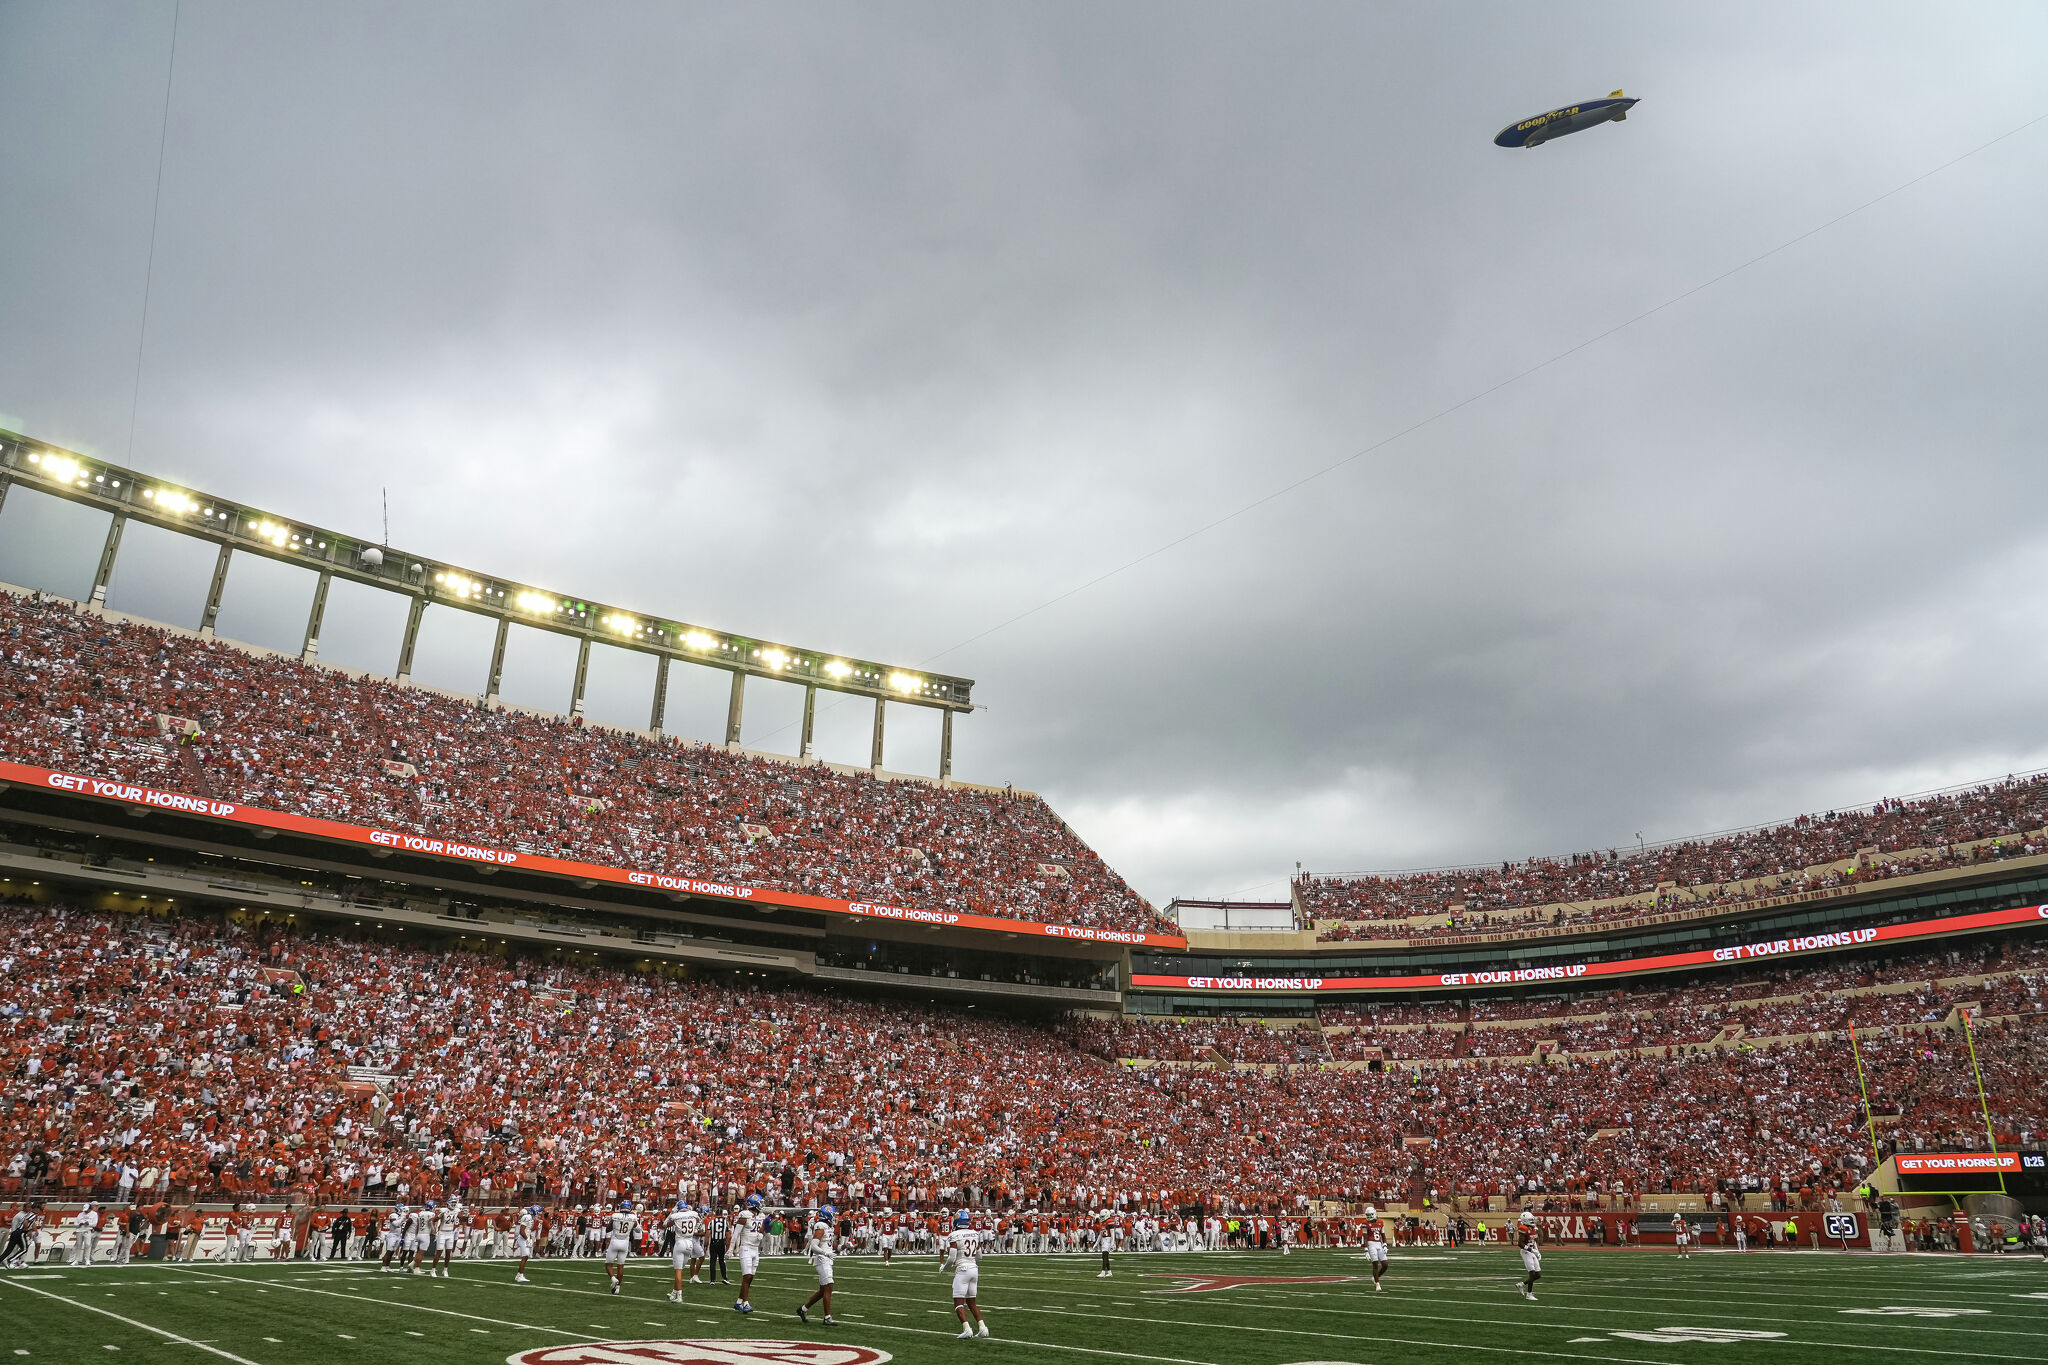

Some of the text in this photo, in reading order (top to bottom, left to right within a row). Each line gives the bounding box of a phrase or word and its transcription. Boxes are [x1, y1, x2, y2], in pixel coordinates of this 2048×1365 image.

[48, 773, 235, 817] GET YOUR HORNS UP
[369, 831, 517, 864] GET YOUR HORNS UP
[628, 872, 753, 898] GET YOUR HORNS UP
[849, 902, 959, 924] GET YOUR HORNS UP
[1045, 925, 1146, 943] GET YOUR HORNS UP
[1713, 928, 1877, 961] GET YOUR HORNS UP
[1187, 977, 1323, 989] GET YOUR HORNS UP
[1440, 964, 1587, 986] GET YOUR HORNS UP
[1901, 1157, 2015, 1169] GET YOUR HORNS UP
[2023, 1156, 2045, 1167] 0:25
[445, 1215, 456, 1225] 24
[619, 1221, 629, 1234] 16
[681, 1220, 694, 1235] 59
[715, 1221, 723, 1232] C
[1465, 1228, 1498, 1241] TEAS
[963, 1239, 977, 1257] 32
